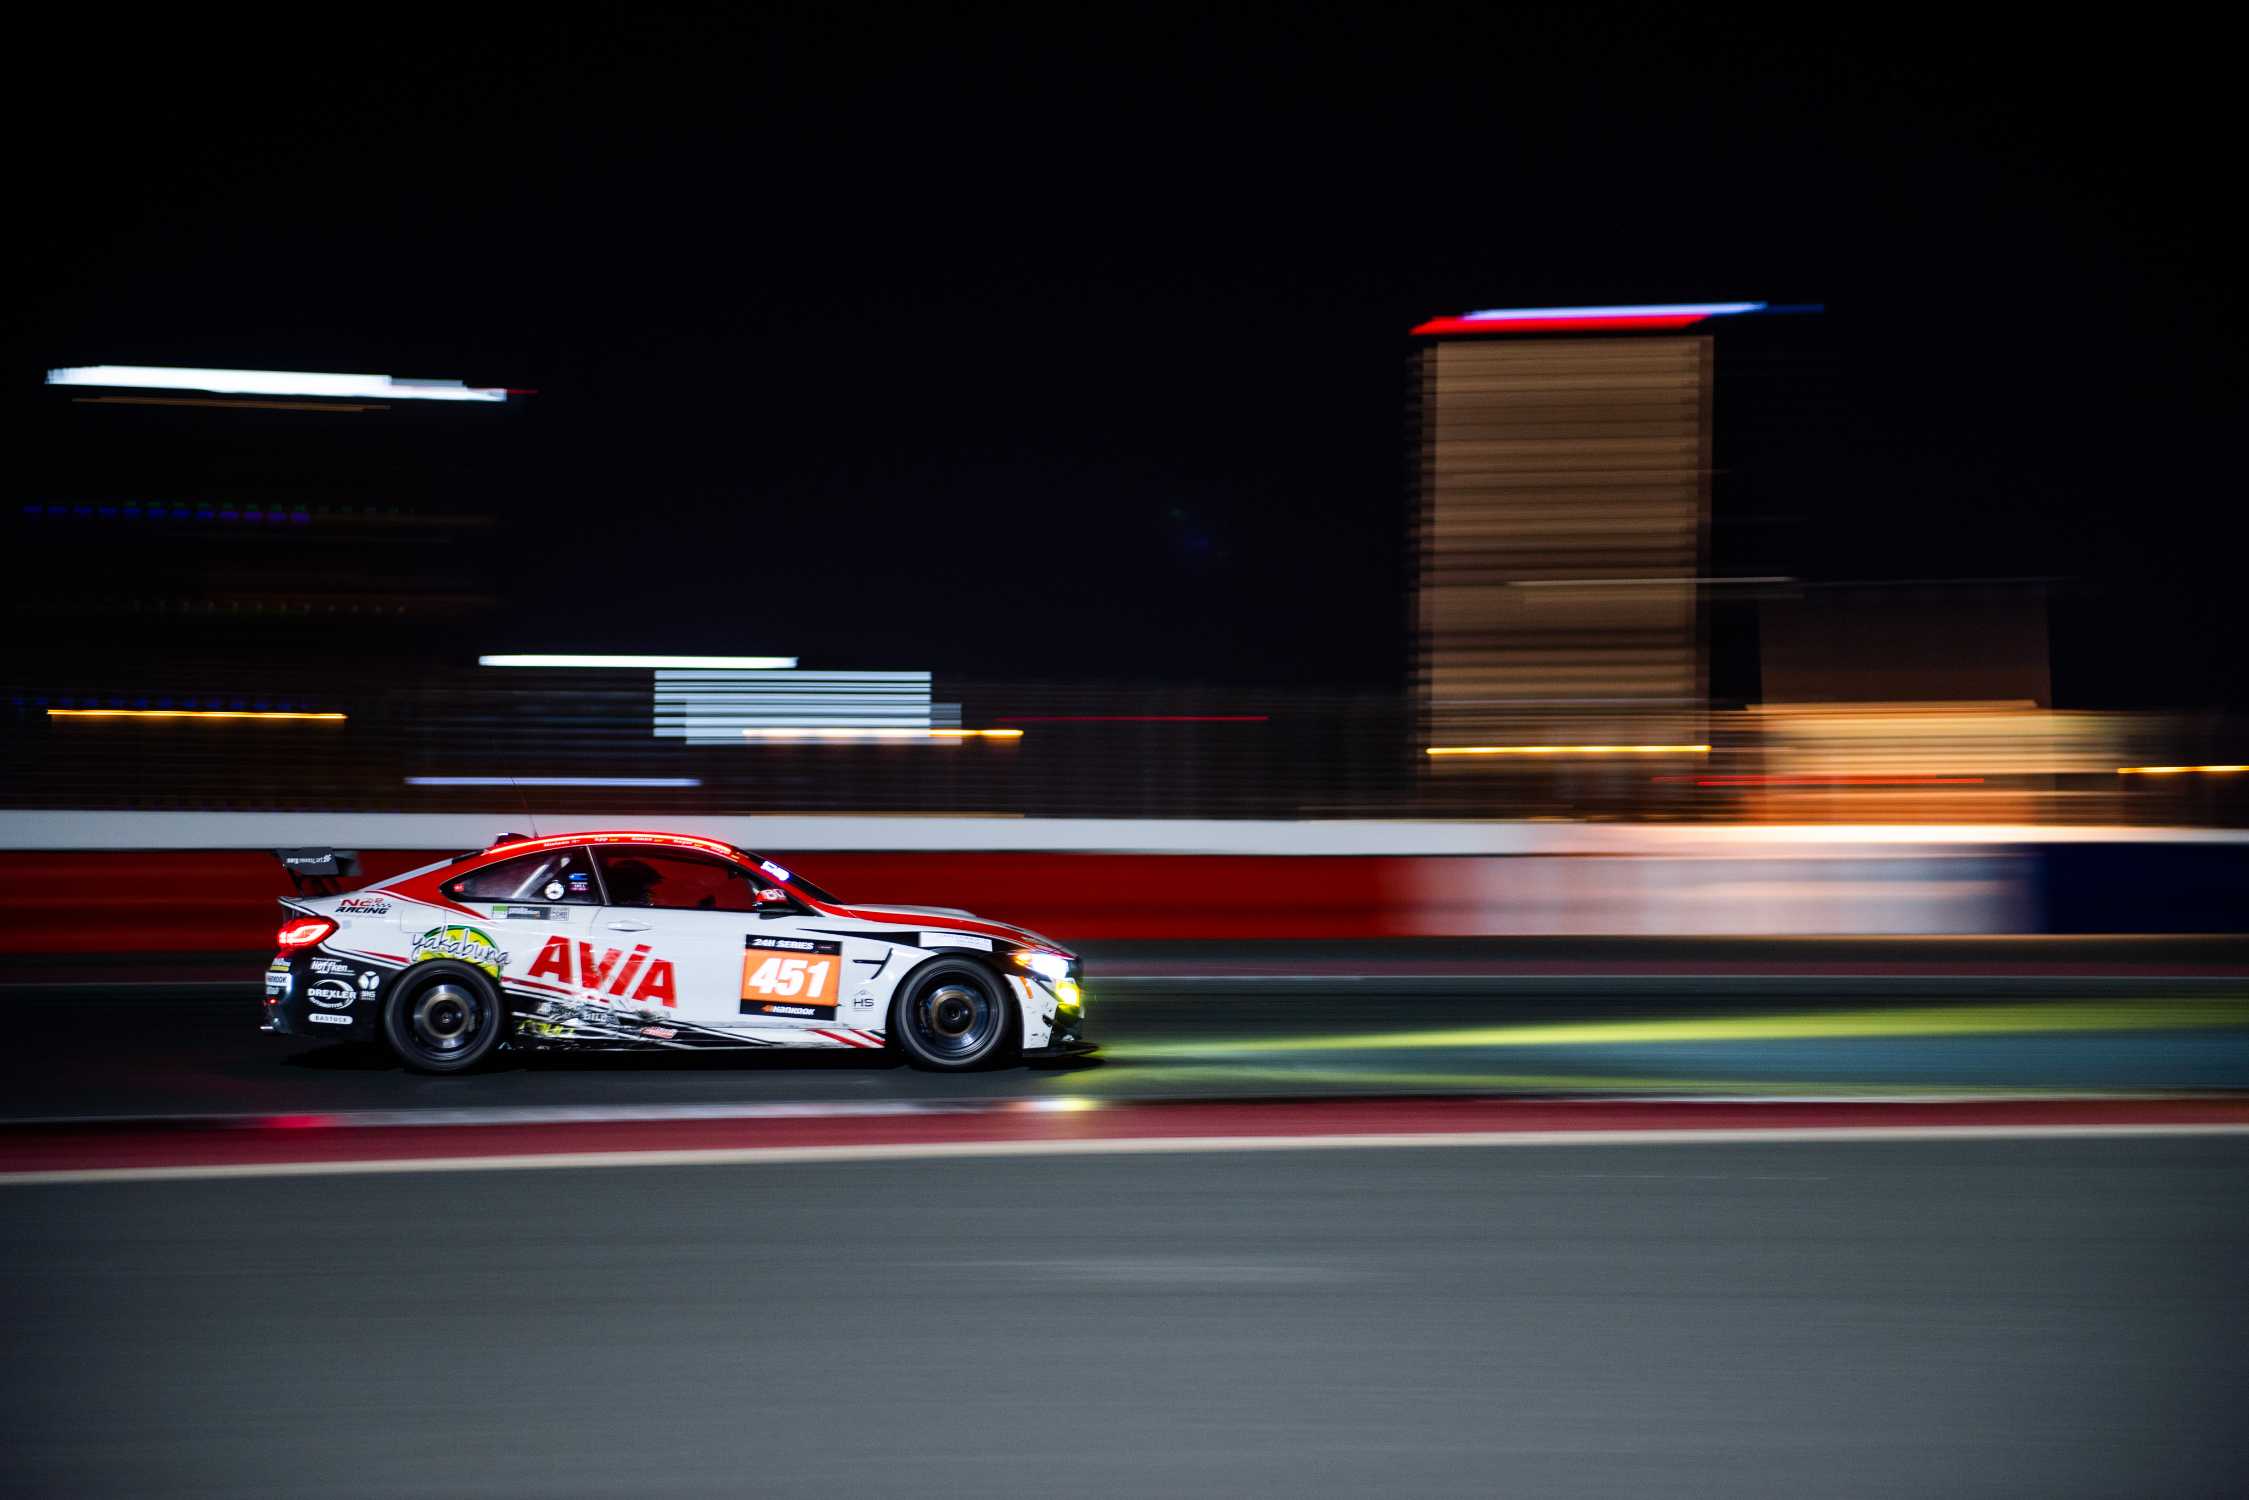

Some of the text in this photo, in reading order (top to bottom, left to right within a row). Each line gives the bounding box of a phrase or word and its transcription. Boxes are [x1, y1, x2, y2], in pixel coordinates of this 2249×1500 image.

[335, 906, 390, 915] RACING
[753, 938, 776, 948] 24H
[777, 939, 815, 950] SERIES
[748, 958, 830, 998] 451
[307, 988, 357, 1000] DREXLER
[853, 998, 875, 1008] HS
